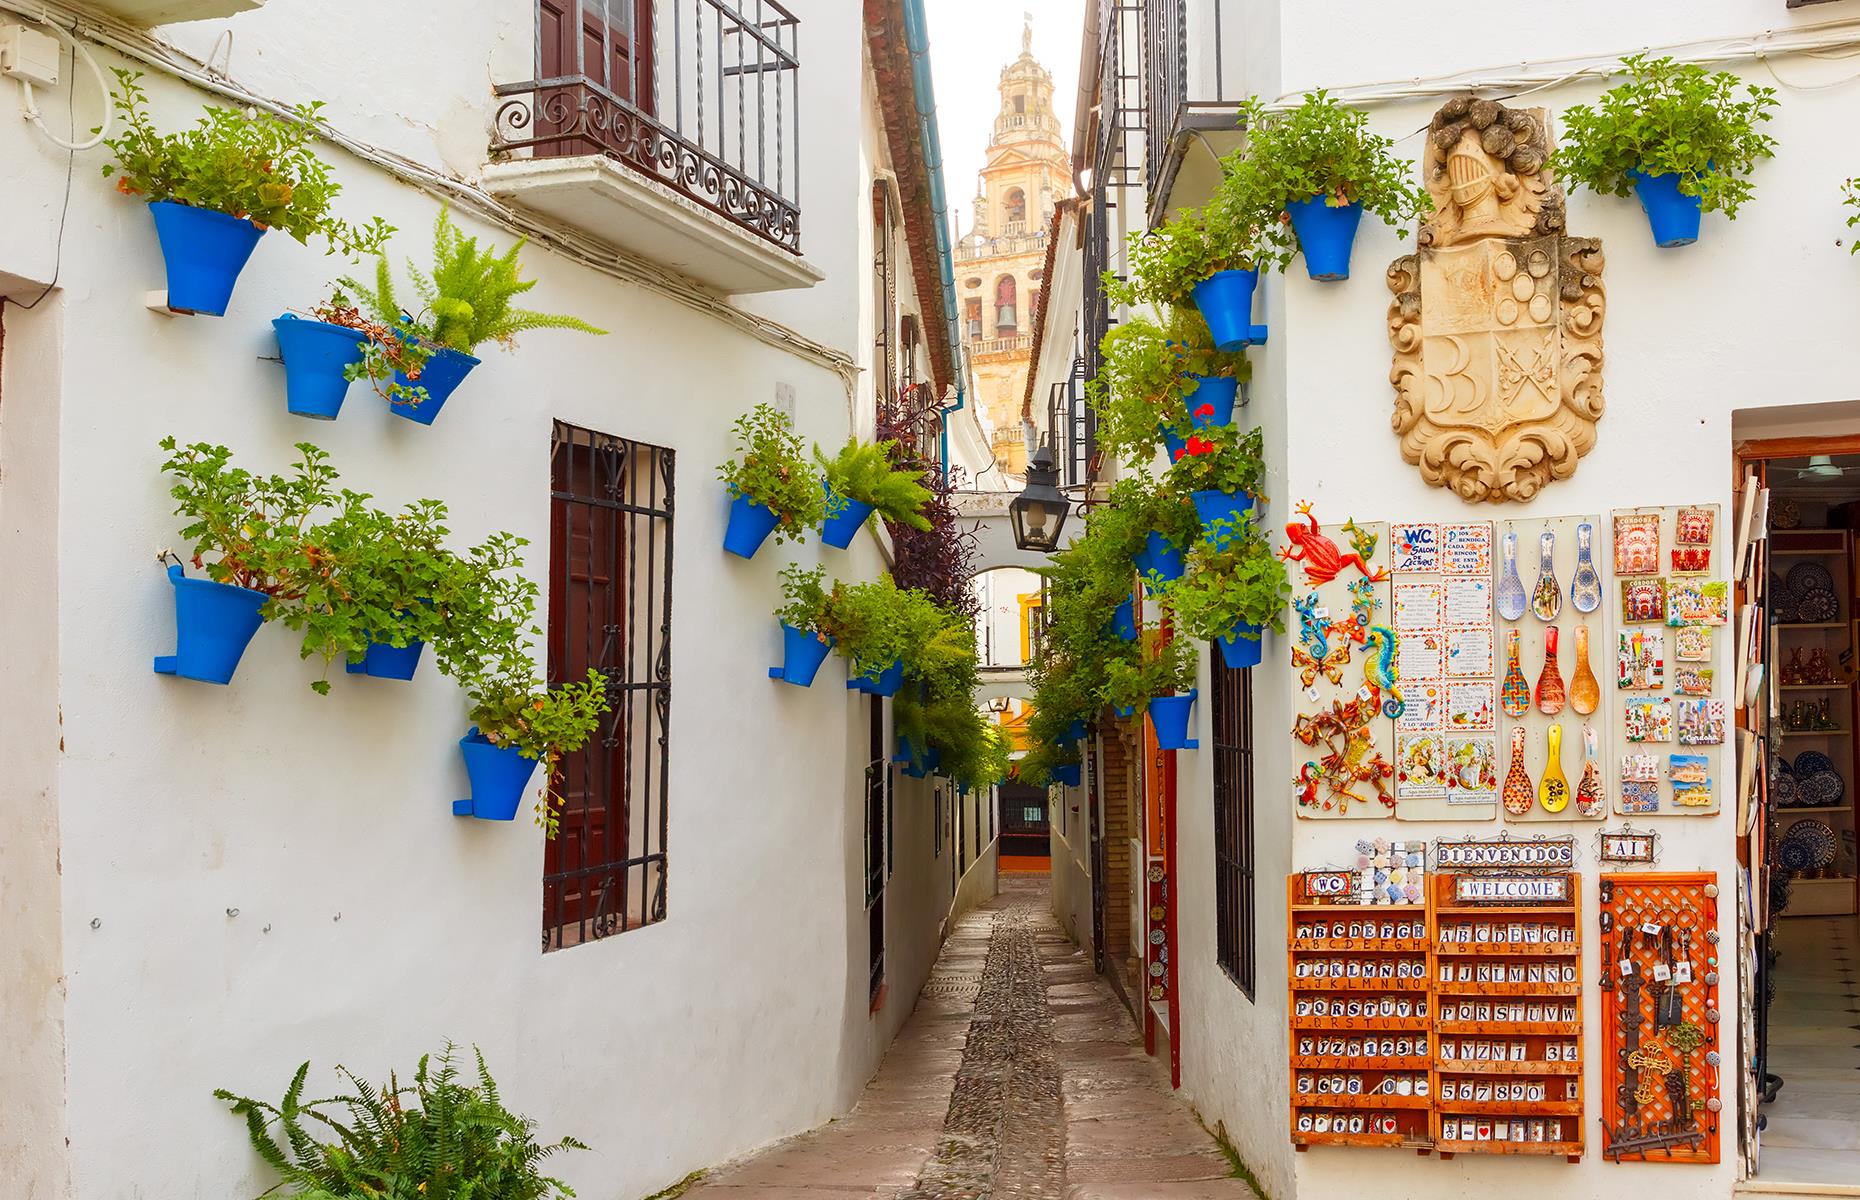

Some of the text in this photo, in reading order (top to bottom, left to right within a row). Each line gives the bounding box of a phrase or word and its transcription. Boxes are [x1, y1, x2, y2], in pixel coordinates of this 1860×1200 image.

[1404, 528, 1433, 543] W.C.
[1411, 546, 1436, 555] SALON
[1439, 848, 1571, 861] BIENVENIDOS
[1319, 879, 1339, 890] WC
[1469, 883, 1554, 895] WELCOME
[1300, 926, 1423, 938] A B C D E F G H
[1442, 929, 1574, 942] A B C D E F G H
[1299, 965, 1304, 975] I
[1316, 965, 1324, 975] J
[1332, 965, 1341, 975] K
[1349, 966, 1358, 975] L
[1365, 968, 1374, 976] M
[1382, 968, 1390, 976] N
[1414, 966, 1422, 976] O
[1444, 968, 1449, 980] I
[1461, 969, 1469, 980] J
[1479, 968, 1488, 980] K
[1495, 970, 1503, 981] L
[1510, 970, 1519, 981] M
[1530, 969, 1539, 980] N
[1564, 968, 1573, 980] O
[1298, 1002, 1426, 1015] P Q R S T U V W
[1443, 1007, 1574, 1020] P Q R S T U V W
[1302, 1043, 1310, 1052] X
[1320, 1043, 1328, 1052] Y
[1333, 1044, 1342, 1053] Z
[1367, 1044, 1375, 1054] 1
[1383, 1044, 1392, 1053] 2
[1398, 1043, 1407, 1053] 3
[1443, 1046, 1452, 1058] X
[1463, 1046, 1473, 1058] Y
[1478, 1046, 1488, 1058] Z
[1516, 1048, 1522, 1060] 1
[1548, 1047, 1557, 1059] 3
[1567, 1048, 1576, 1060] 4
[1299, 1080, 1308, 1091] 5
[1320, 1081, 1328, 1090] 6
[1333, 1080, 1342, 1091] 7
[1349, 1081, 1359, 1092] 8
[1444, 1086, 1452, 1098] 5
[1461, 1085, 1470, 1098] 6
[1478, 1088, 1487, 1099] 7
[1497, 1087, 1507, 1098] 8
[1513, 1086, 1522, 1098] 9
